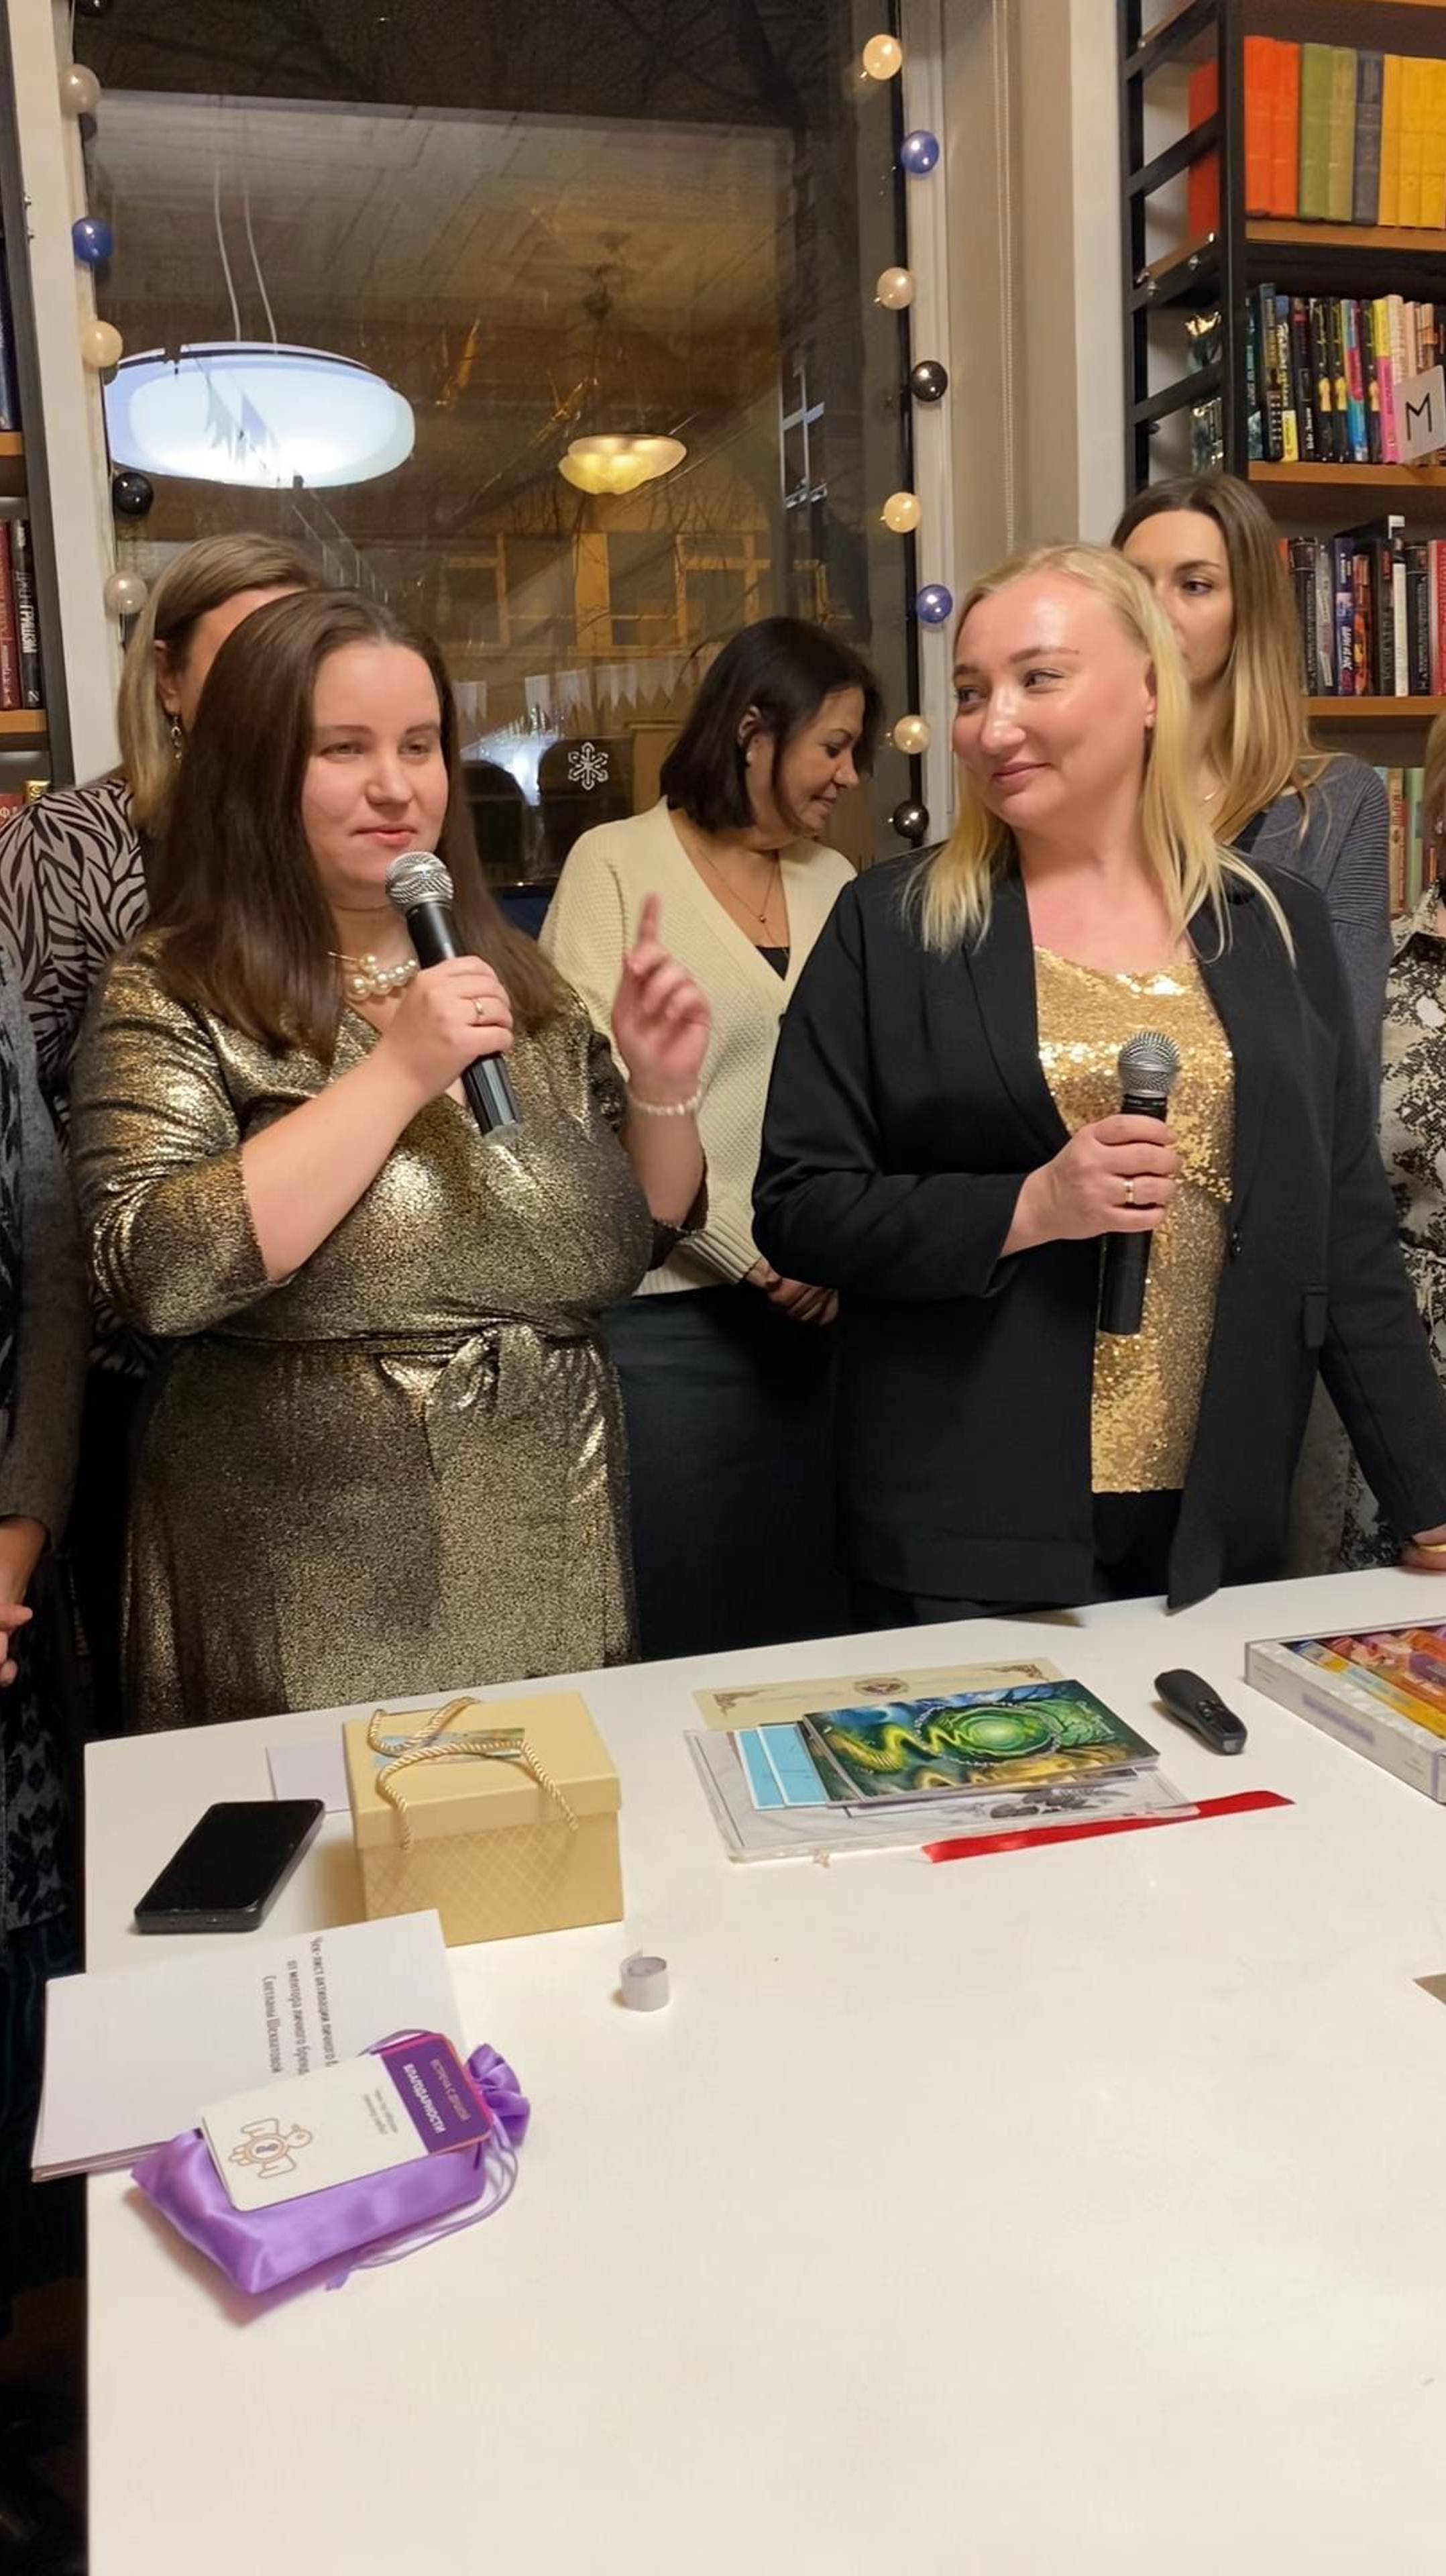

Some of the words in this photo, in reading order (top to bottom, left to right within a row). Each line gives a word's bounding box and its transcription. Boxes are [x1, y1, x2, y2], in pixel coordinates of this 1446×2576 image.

[1404, 392, 1432, 441] М
[19, 604, 38, 653] ГРИШЭМ
[287, 1970, 302, 2008] ментора
[292, 2008, 307, 2045] личного
[321, 2023, 335, 2060] личного
[403, 2063, 447, 2134] БЛАГОДАРНОСТИ
